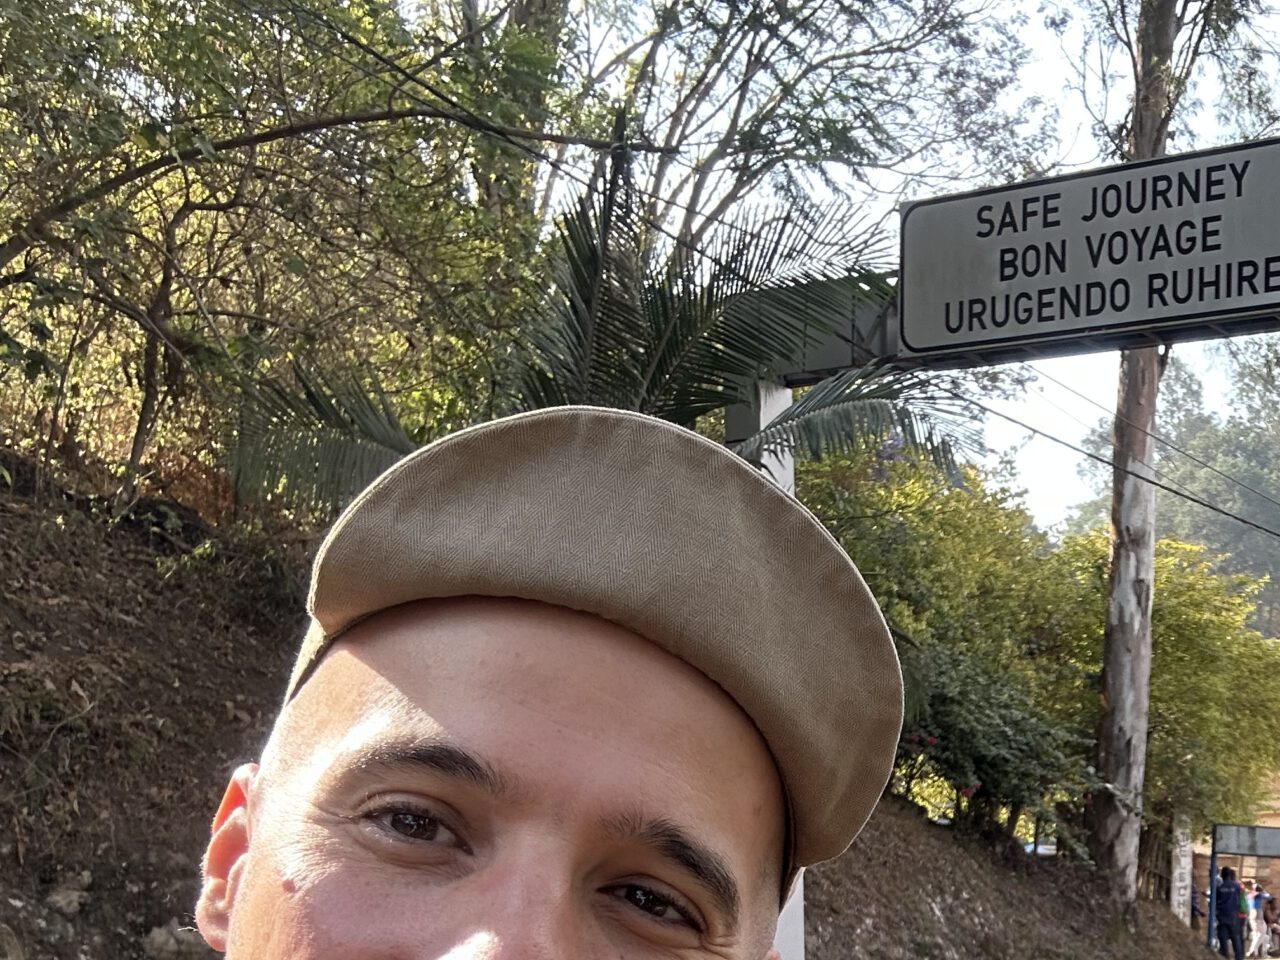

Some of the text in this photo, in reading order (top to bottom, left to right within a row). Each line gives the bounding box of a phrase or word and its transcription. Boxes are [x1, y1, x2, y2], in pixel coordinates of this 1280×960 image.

[976, 161, 1250, 238] SAFE JOURNEY
[1000, 215, 1222, 282] BON VOYAGE
[945, 278, 1130, 333] URUGENDO
